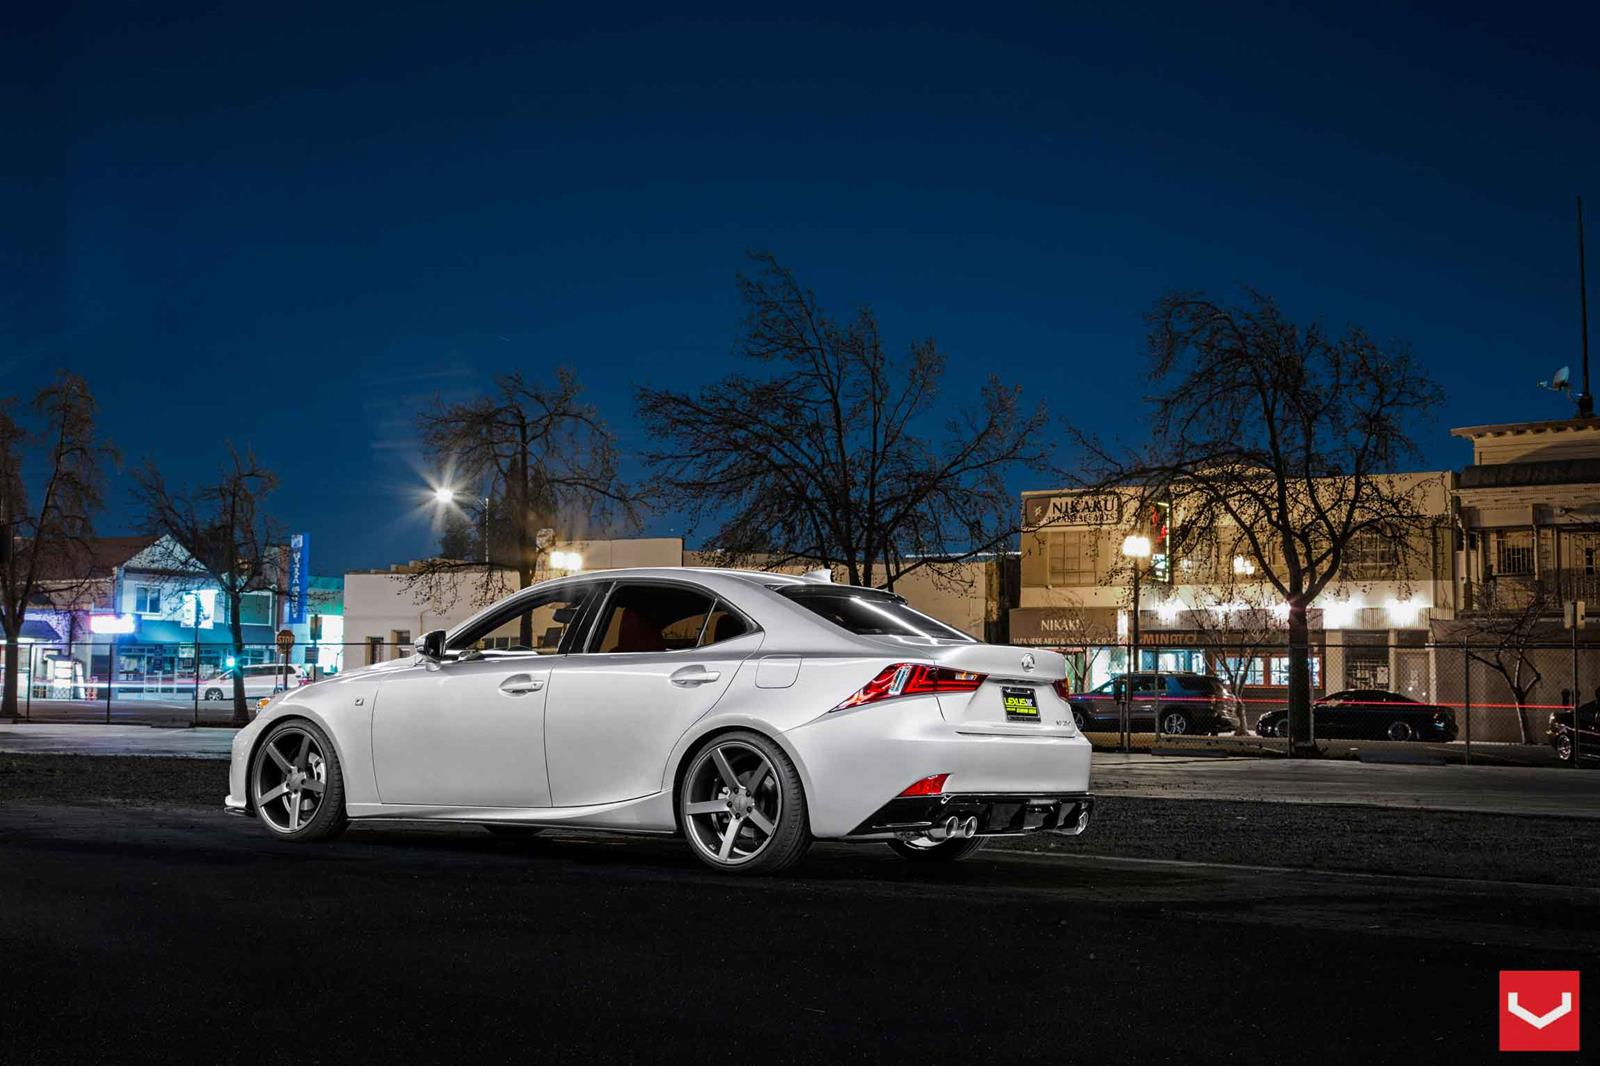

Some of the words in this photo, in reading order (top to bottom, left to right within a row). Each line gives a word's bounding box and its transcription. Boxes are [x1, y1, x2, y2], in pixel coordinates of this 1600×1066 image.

[1052, 498, 1115, 514] NIKAKU
[278, 635, 294, 643] STOP
[1143, 634, 1197, 645] MINATO
